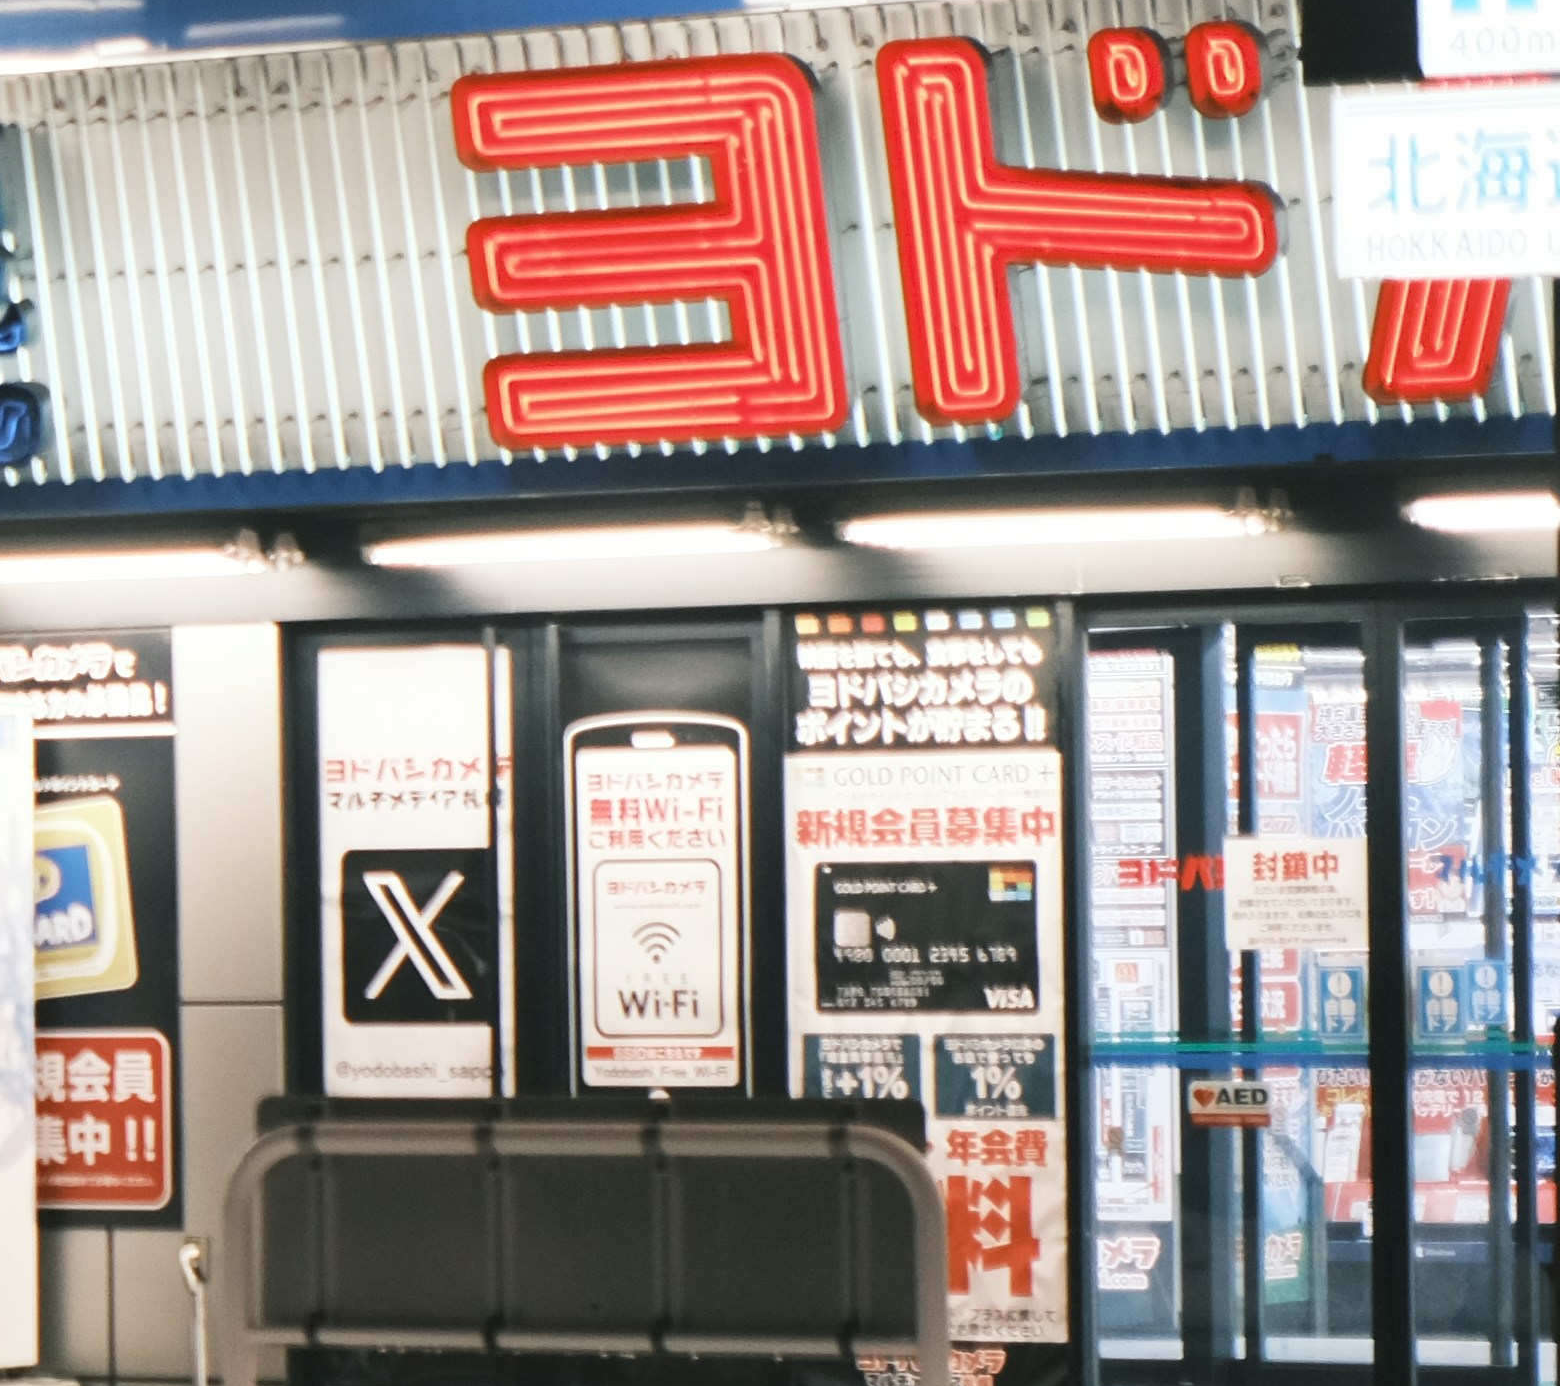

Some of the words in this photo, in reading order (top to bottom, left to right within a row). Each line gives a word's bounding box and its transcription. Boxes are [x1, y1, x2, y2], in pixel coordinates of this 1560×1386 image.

[1449, 27, 1558, 57] 400m
[1367, 126, 1560, 215] 北海
[1367, 227, 1528, 264] HOKKAIDO
[807, 667, 1035, 708] ヨドバシカメラの
[587, 772, 725, 792] ヨドバシカメラ
[833, 767, 893, 787] GOLD
[900, 766, 966, 785] POINT
[972, 764, 1030, 784] CARD
[590, 798, 724, 826] 無料Wi-Fi
[589, 829, 726, 850] ご利用ください
[795, 806, 1057, 850] 新規会員募集中
[1252, 850, 1339, 882] 封鎖中
[607, 882, 707, 896] ヨドバシカメラ
[362, 870, 474, 1001] X
[983, 986, 1035, 1009] VISA
[335, 1060, 496, 1084] @yodobashi_sapp
[835, 1066, 911, 1100] +1%
[971, 1066, 1023, 1100] 1%
[1215, 1087, 1268, 1106] AED
[946, 1129, 1047, 1167] 年会費
[855, 1349, 1007, 1375] ヨドバメラ
